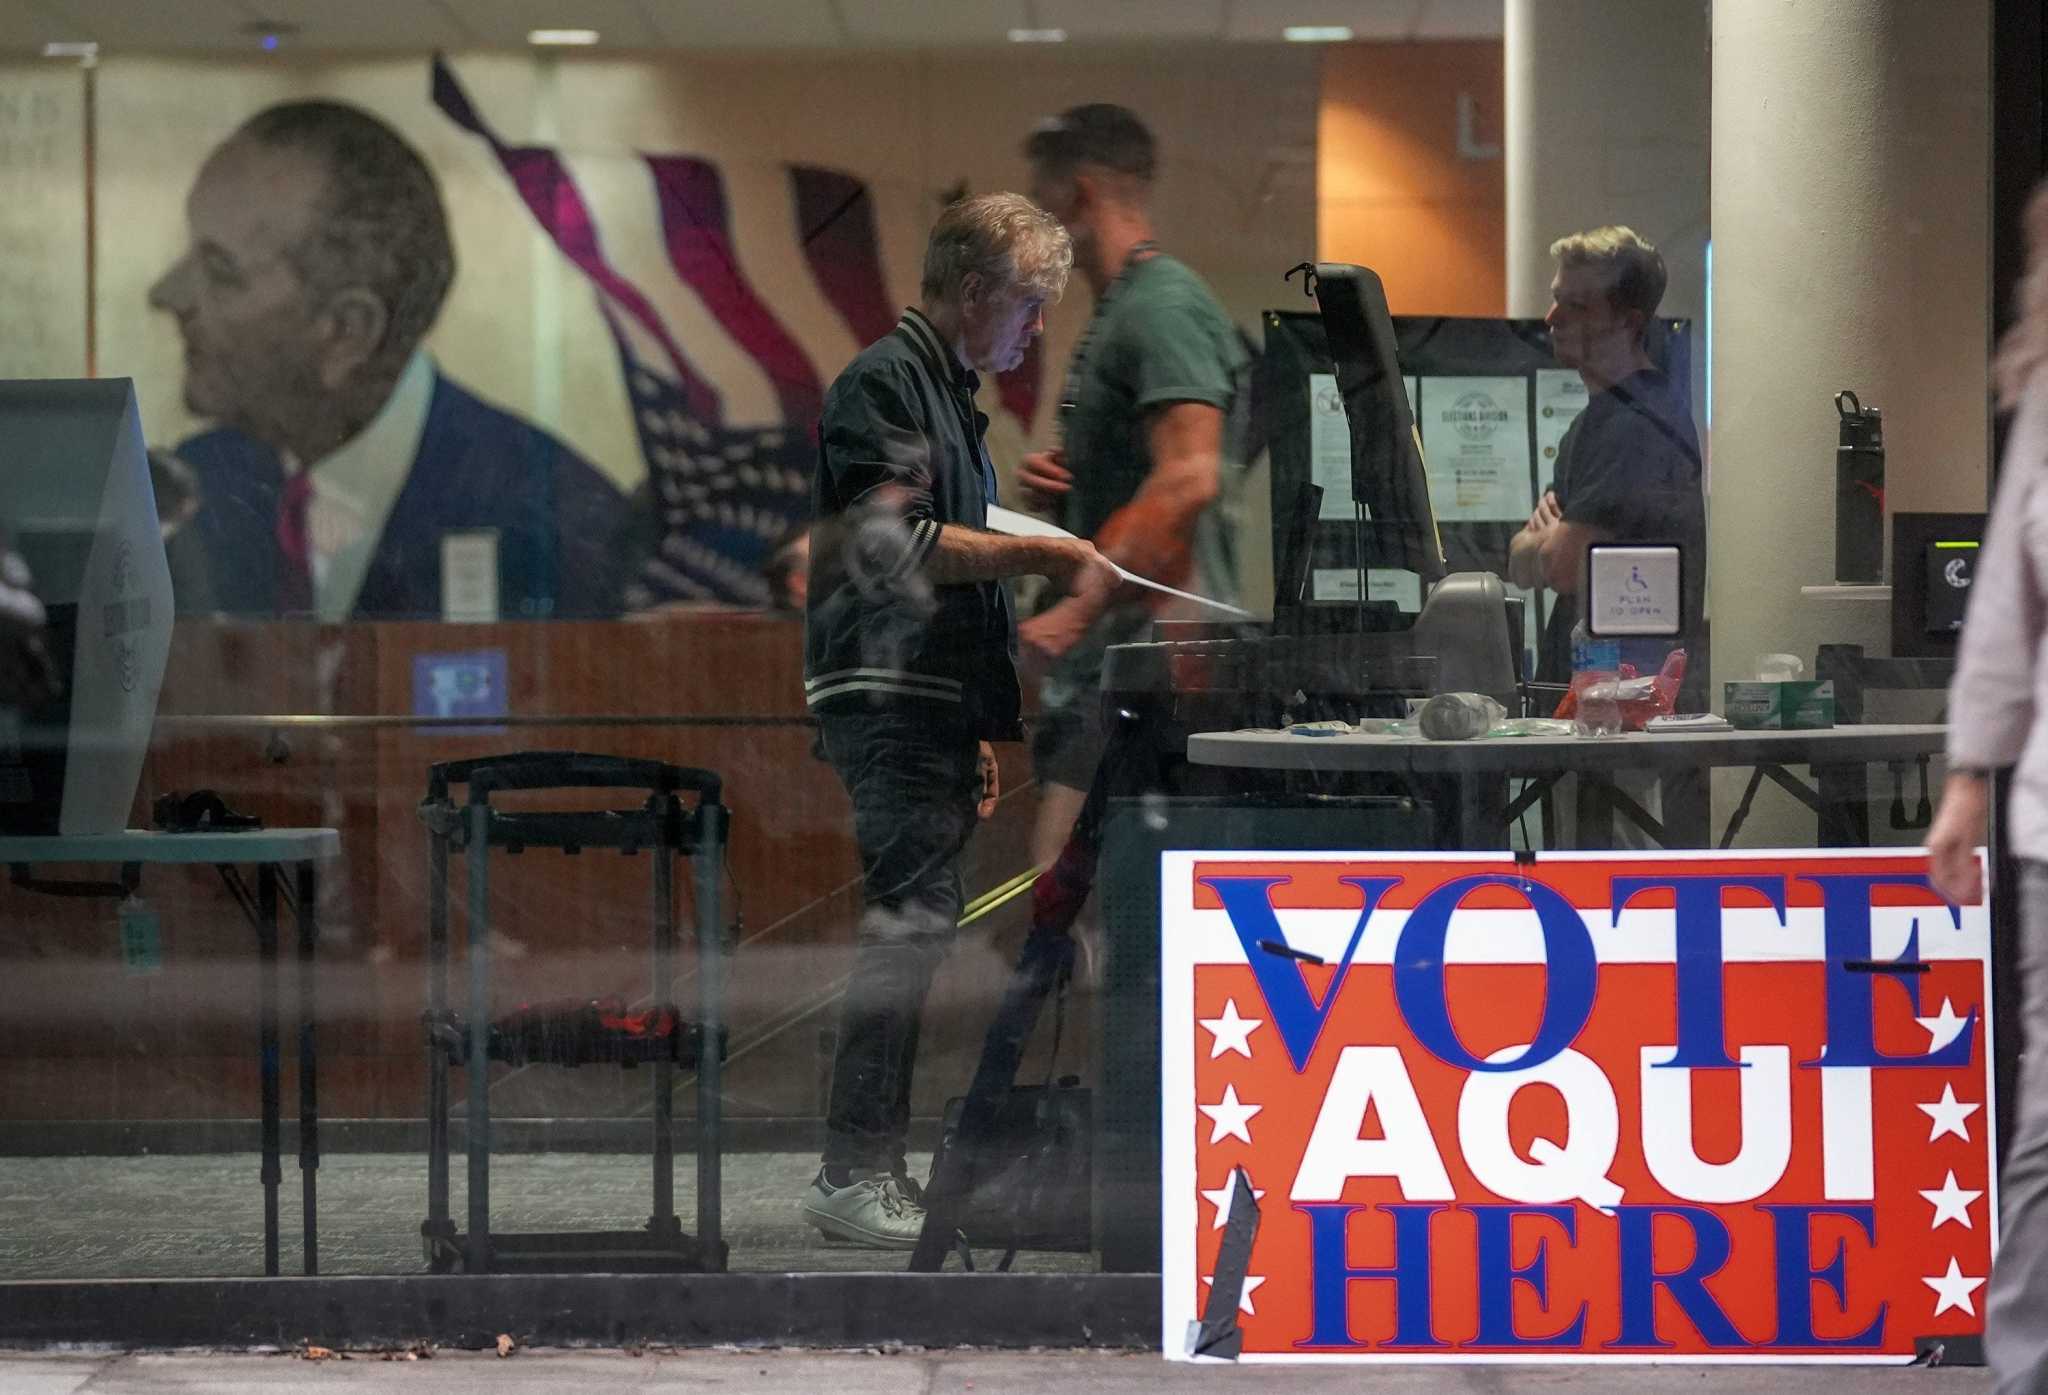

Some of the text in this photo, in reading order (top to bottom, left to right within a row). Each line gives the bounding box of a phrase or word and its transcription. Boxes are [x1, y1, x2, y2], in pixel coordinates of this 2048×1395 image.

[1198, 872, 1978, 1074] VOTE
[1290, 1044, 1875, 1216] AQUI
[1292, 1203, 1888, 1348] HERE
